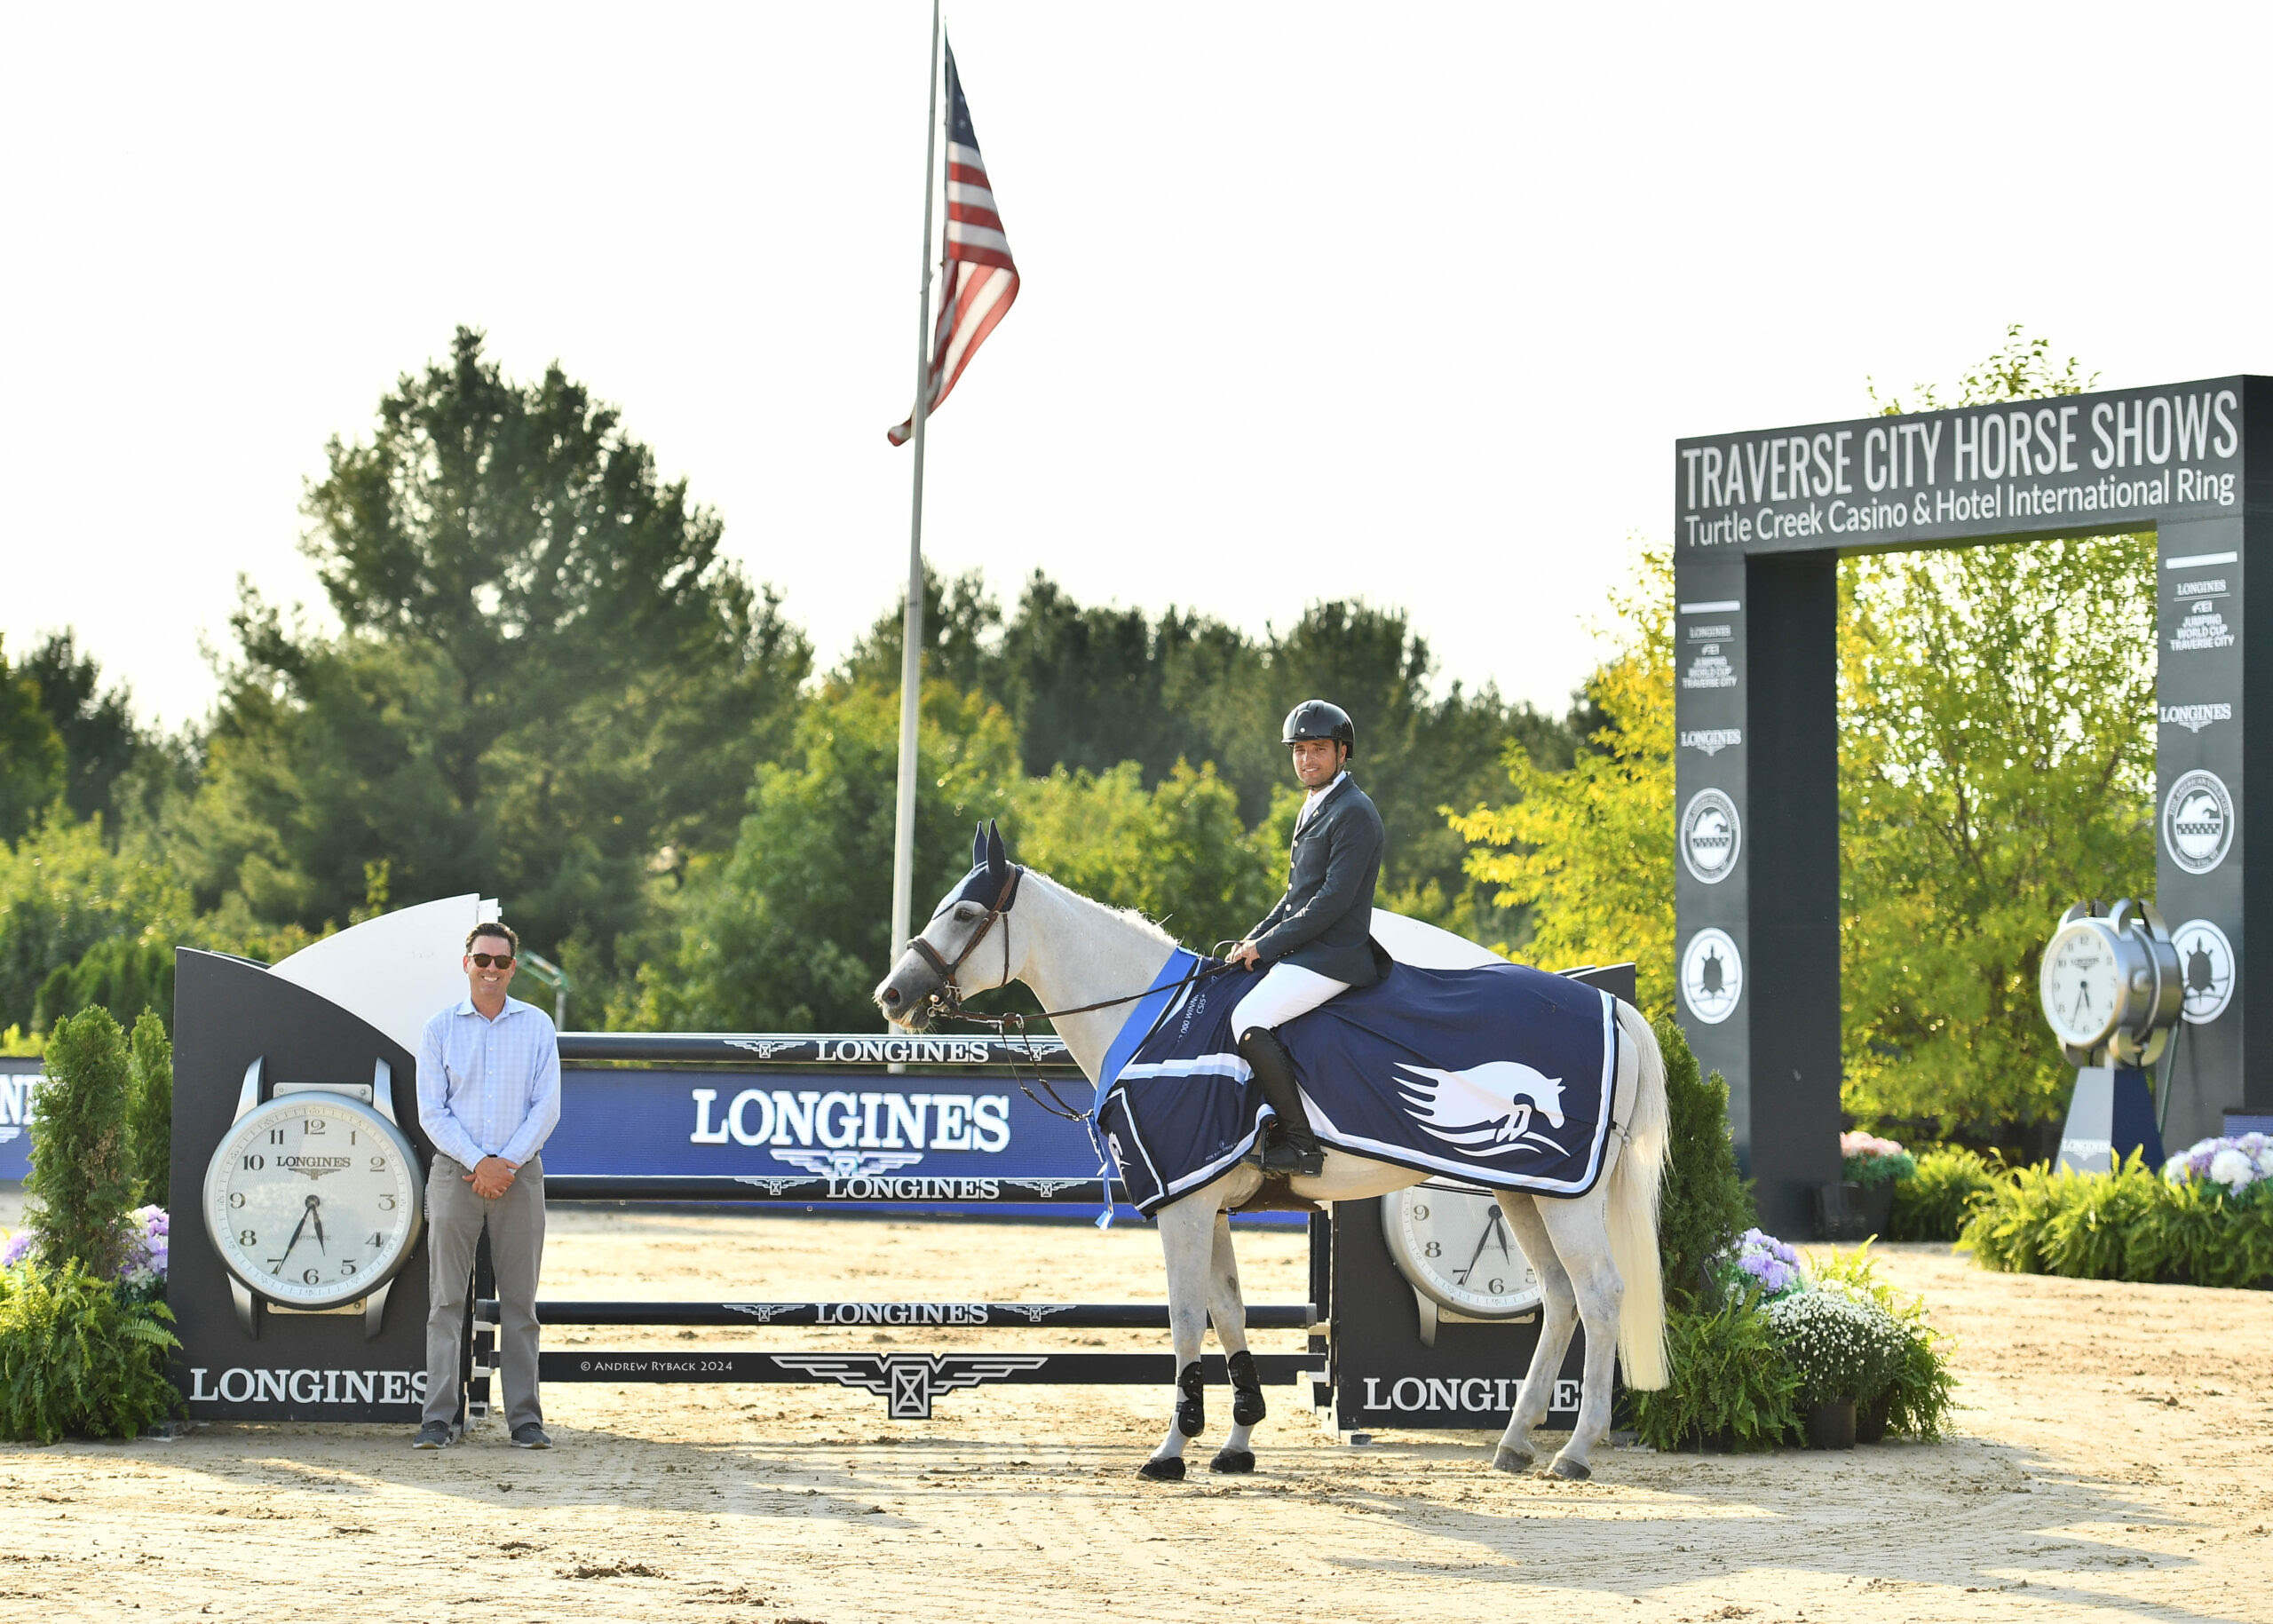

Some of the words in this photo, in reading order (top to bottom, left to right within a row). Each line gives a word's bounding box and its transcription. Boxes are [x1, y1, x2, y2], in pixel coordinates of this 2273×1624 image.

[1682, 430, 1853, 511] TRAVERSE
[1865, 420, 1943, 493] CITY
[1954, 406, 2079, 482] HORSE
[2091, 390, 2238, 471] SHOWS
[1683, 510, 1753, 547] Turtle
[1756, 502, 1824, 541] Creek
[1828, 497, 1908, 534] Casino
[1913, 491, 1933, 527] &
[1936, 483, 2001, 522] Hotel
[2008, 469, 2170, 518] International
[2177, 468, 2236, 506] Ring
[2177, 579, 2227, 596] LONGINES
[2182, 613, 2222, 628] JUMPING
[2177, 626, 2208, 640] WORLD
[2209, 623, 2229, 637] CUP
[2170, 637, 2214, 652] TRAVERSE
[2214, 634, 2236, 648] CITY
[2159, 703, 2232, 723] LONGINES
[1680, 728, 1742, 748] LONGINES
[815, 1040, 990, 1063] LONGINES
[303, 1119, 326, 1136] 12
[690, 1088, 1011, 1153] LONGINES
[270, 1129, 284, 1145] 11
[350, 1130, 356, 1145] 1
[243, 1154, 265, 1171] 10
[276, 1156, 352, 1168] LONGINES
[369, 1157, 385, 1172] 2
[826, 1177, 1000, 1200] LONGINES
[229, 1192, 246, 1208] 9
[378, 1194, 396, 1211] 3
[1414, 1204, 1430, 1221] 9
[239, 1230, 257, 1247] 8
[365, 1232, 384, 1248] 4
[1424, 1241, 1442, 1258] 8
[266, 1258, 283, 1275] 7
[340, 1259, 356, 1275] 5
[303, 1269, 320, 1285] 6
[1453, 1269, 1469, 1286] 7
[1525, 1268, 1538, 1283] 5
[1488, 1279, 1504, 1295] 6
[814, 1302, 989, 1325] LONGINES
[1363, 1377, 1584, 1412] LONGIE
